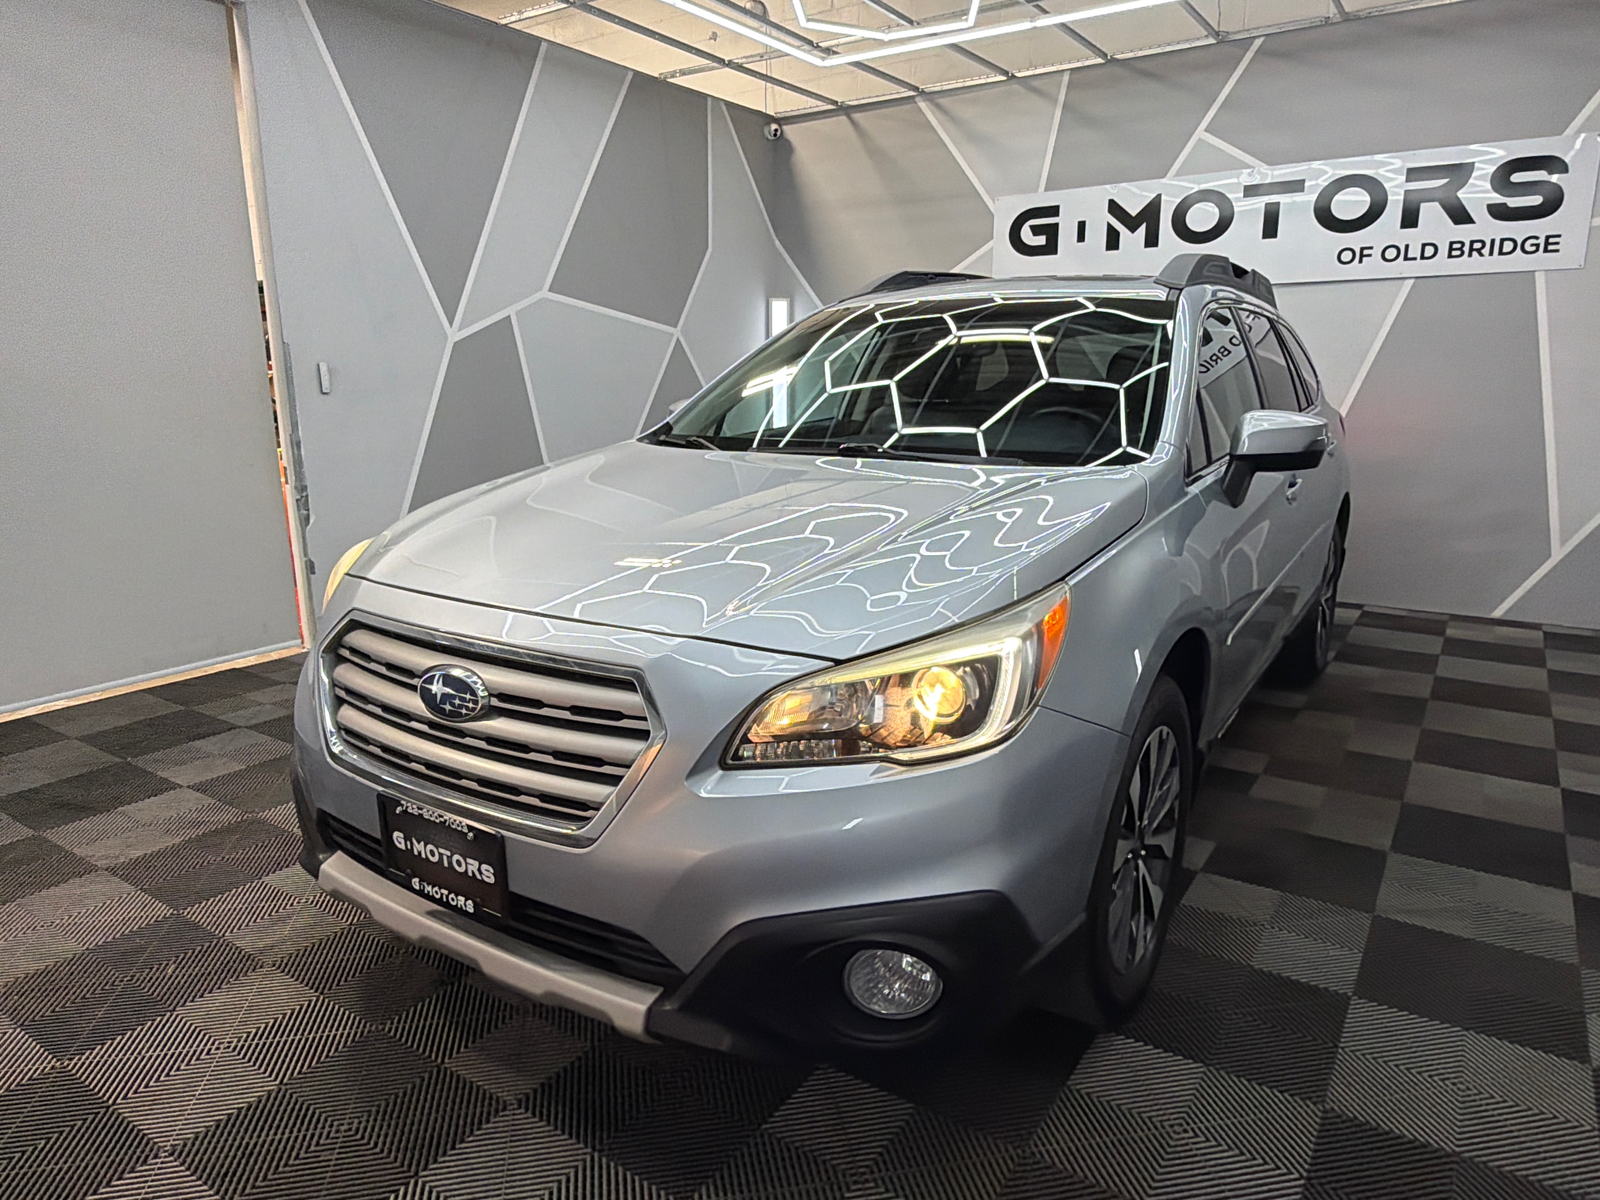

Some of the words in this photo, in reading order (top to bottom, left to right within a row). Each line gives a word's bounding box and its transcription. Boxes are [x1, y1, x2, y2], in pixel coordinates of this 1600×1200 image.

[1336, 246, 1374, 265] OF
[1380, 242, 1439, 262] OLD
[1446, 234, 1562, 259] BRIDGE
